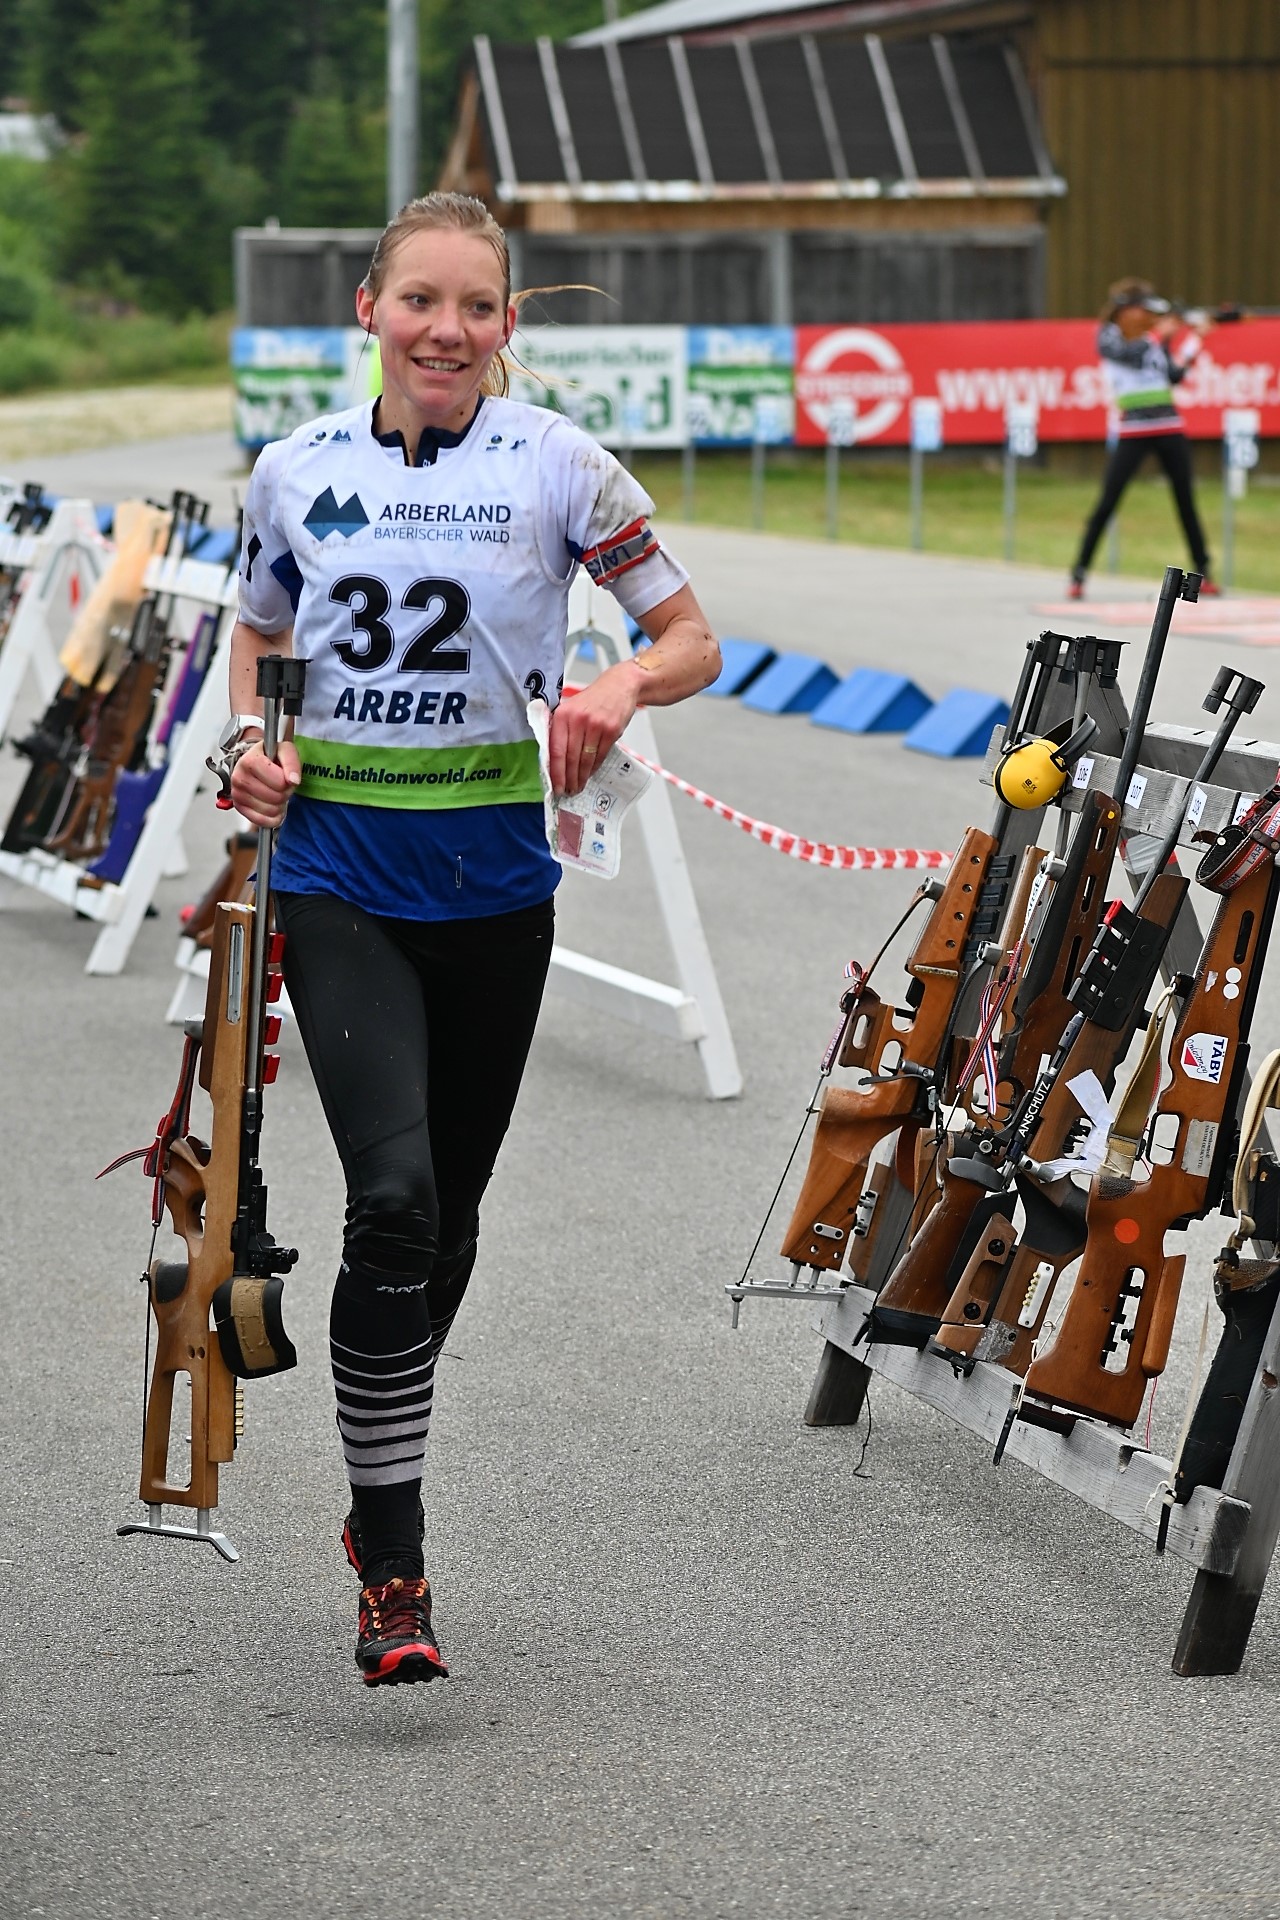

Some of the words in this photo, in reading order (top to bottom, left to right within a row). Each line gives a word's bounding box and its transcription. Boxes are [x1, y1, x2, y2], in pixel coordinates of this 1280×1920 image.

[378, 503, 511, 523] ARBERLAND
[374, 527, 463, 541] BAYERISCHER
[470, 529, 510, 543] WALD
[328, 573, 471, 674] 32
[333, 687, 467, 725] ARBER
[302, 762, 502, 785] www.biathlonworld.com
[1208, 1038, 1226, 1082] TÄBY
